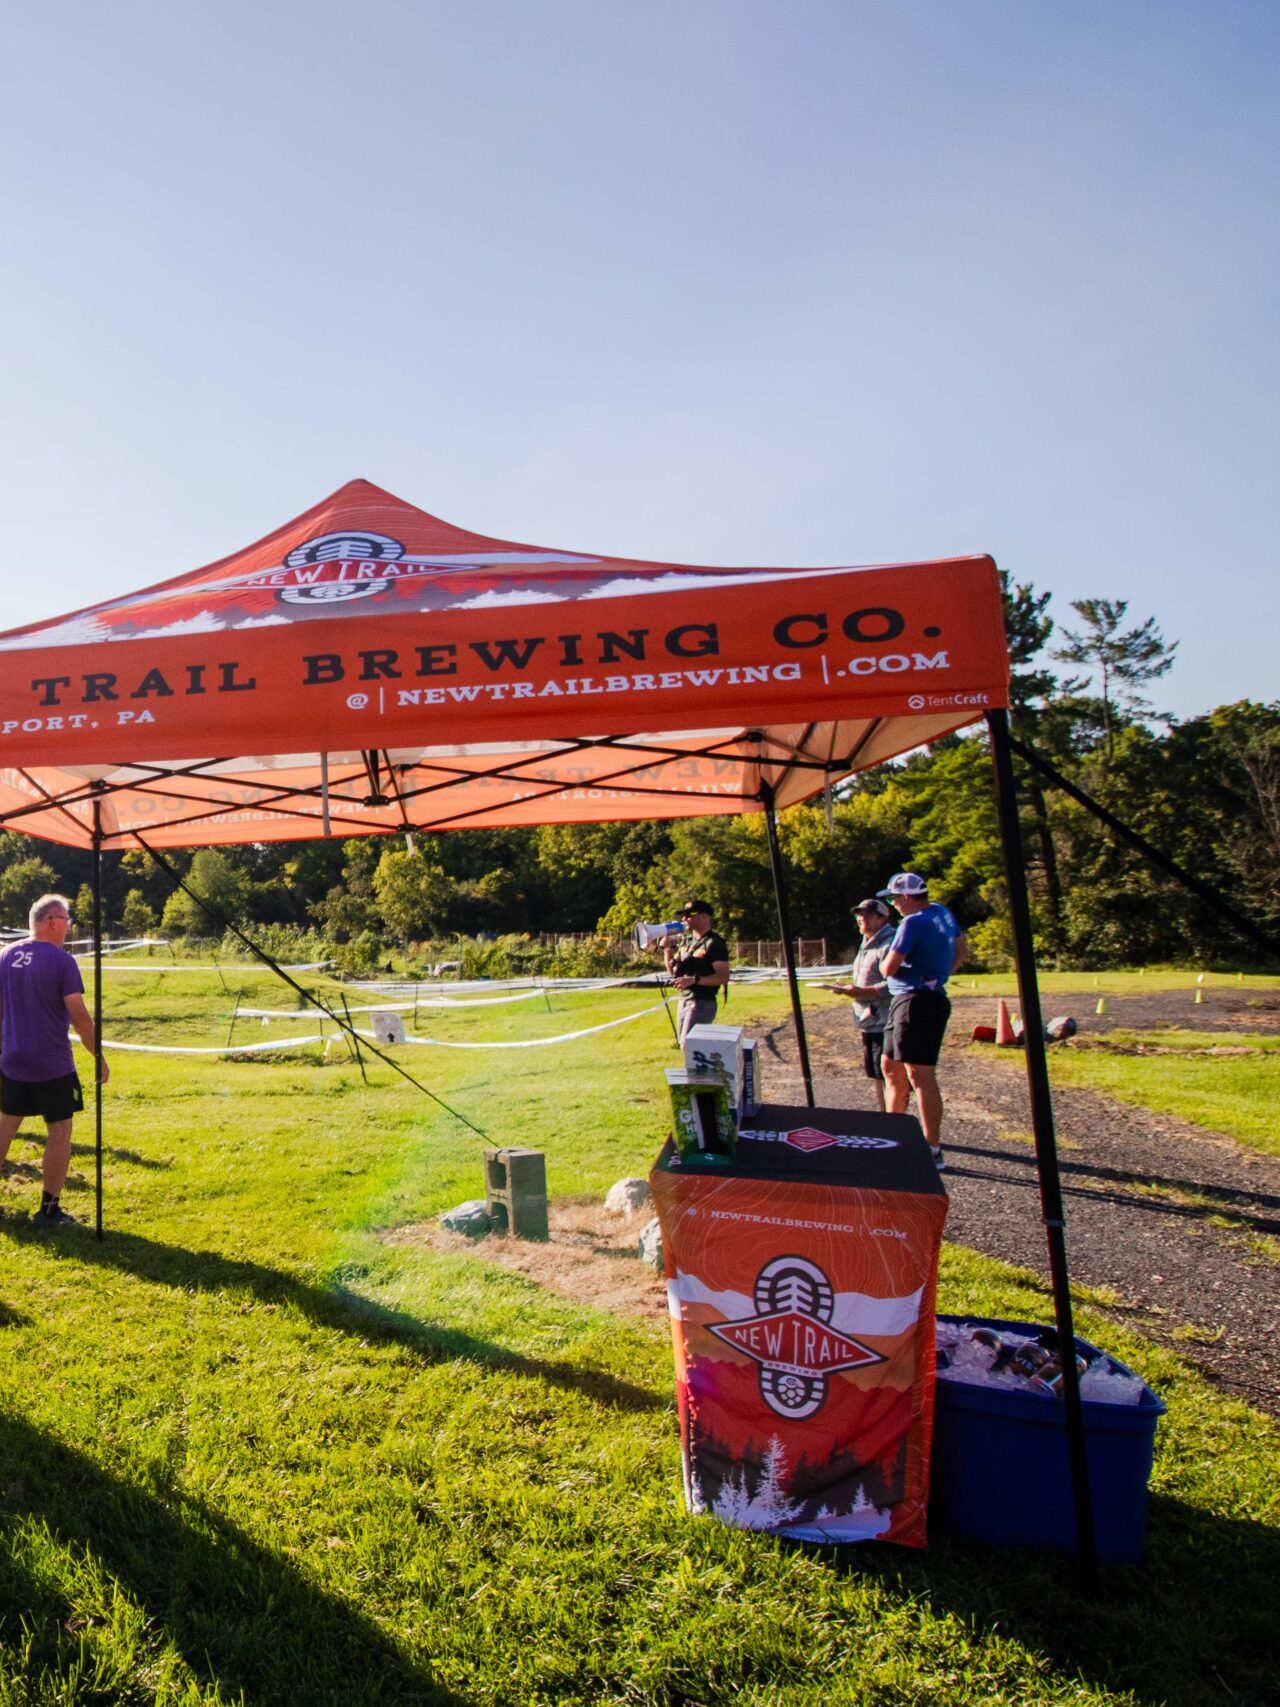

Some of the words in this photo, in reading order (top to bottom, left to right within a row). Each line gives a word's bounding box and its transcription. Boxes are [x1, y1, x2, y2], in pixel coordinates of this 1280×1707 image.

[247, 564, 323, 586] NEW
[339, 561, 437, 584] TRAIL
[31, 663, 256, 706] TRAIL
[303, 623, 719, 685] BREWING
[773, 607, 941, 648] CO.
[397, 662, 801, 706] NEWTRAILBREWING
[837, 651, 949, 677] .COM
[928, 693, 989, 706] TentCraft
[117, 710, 155, 725] PA
[11, 951, 34, 968] 25
[710, 1210, 853, 1233] NEWTRAILBREWING
[735, 1322, 784, 1358] NEW
[792, 1320, 853, 1365] TRAIL
